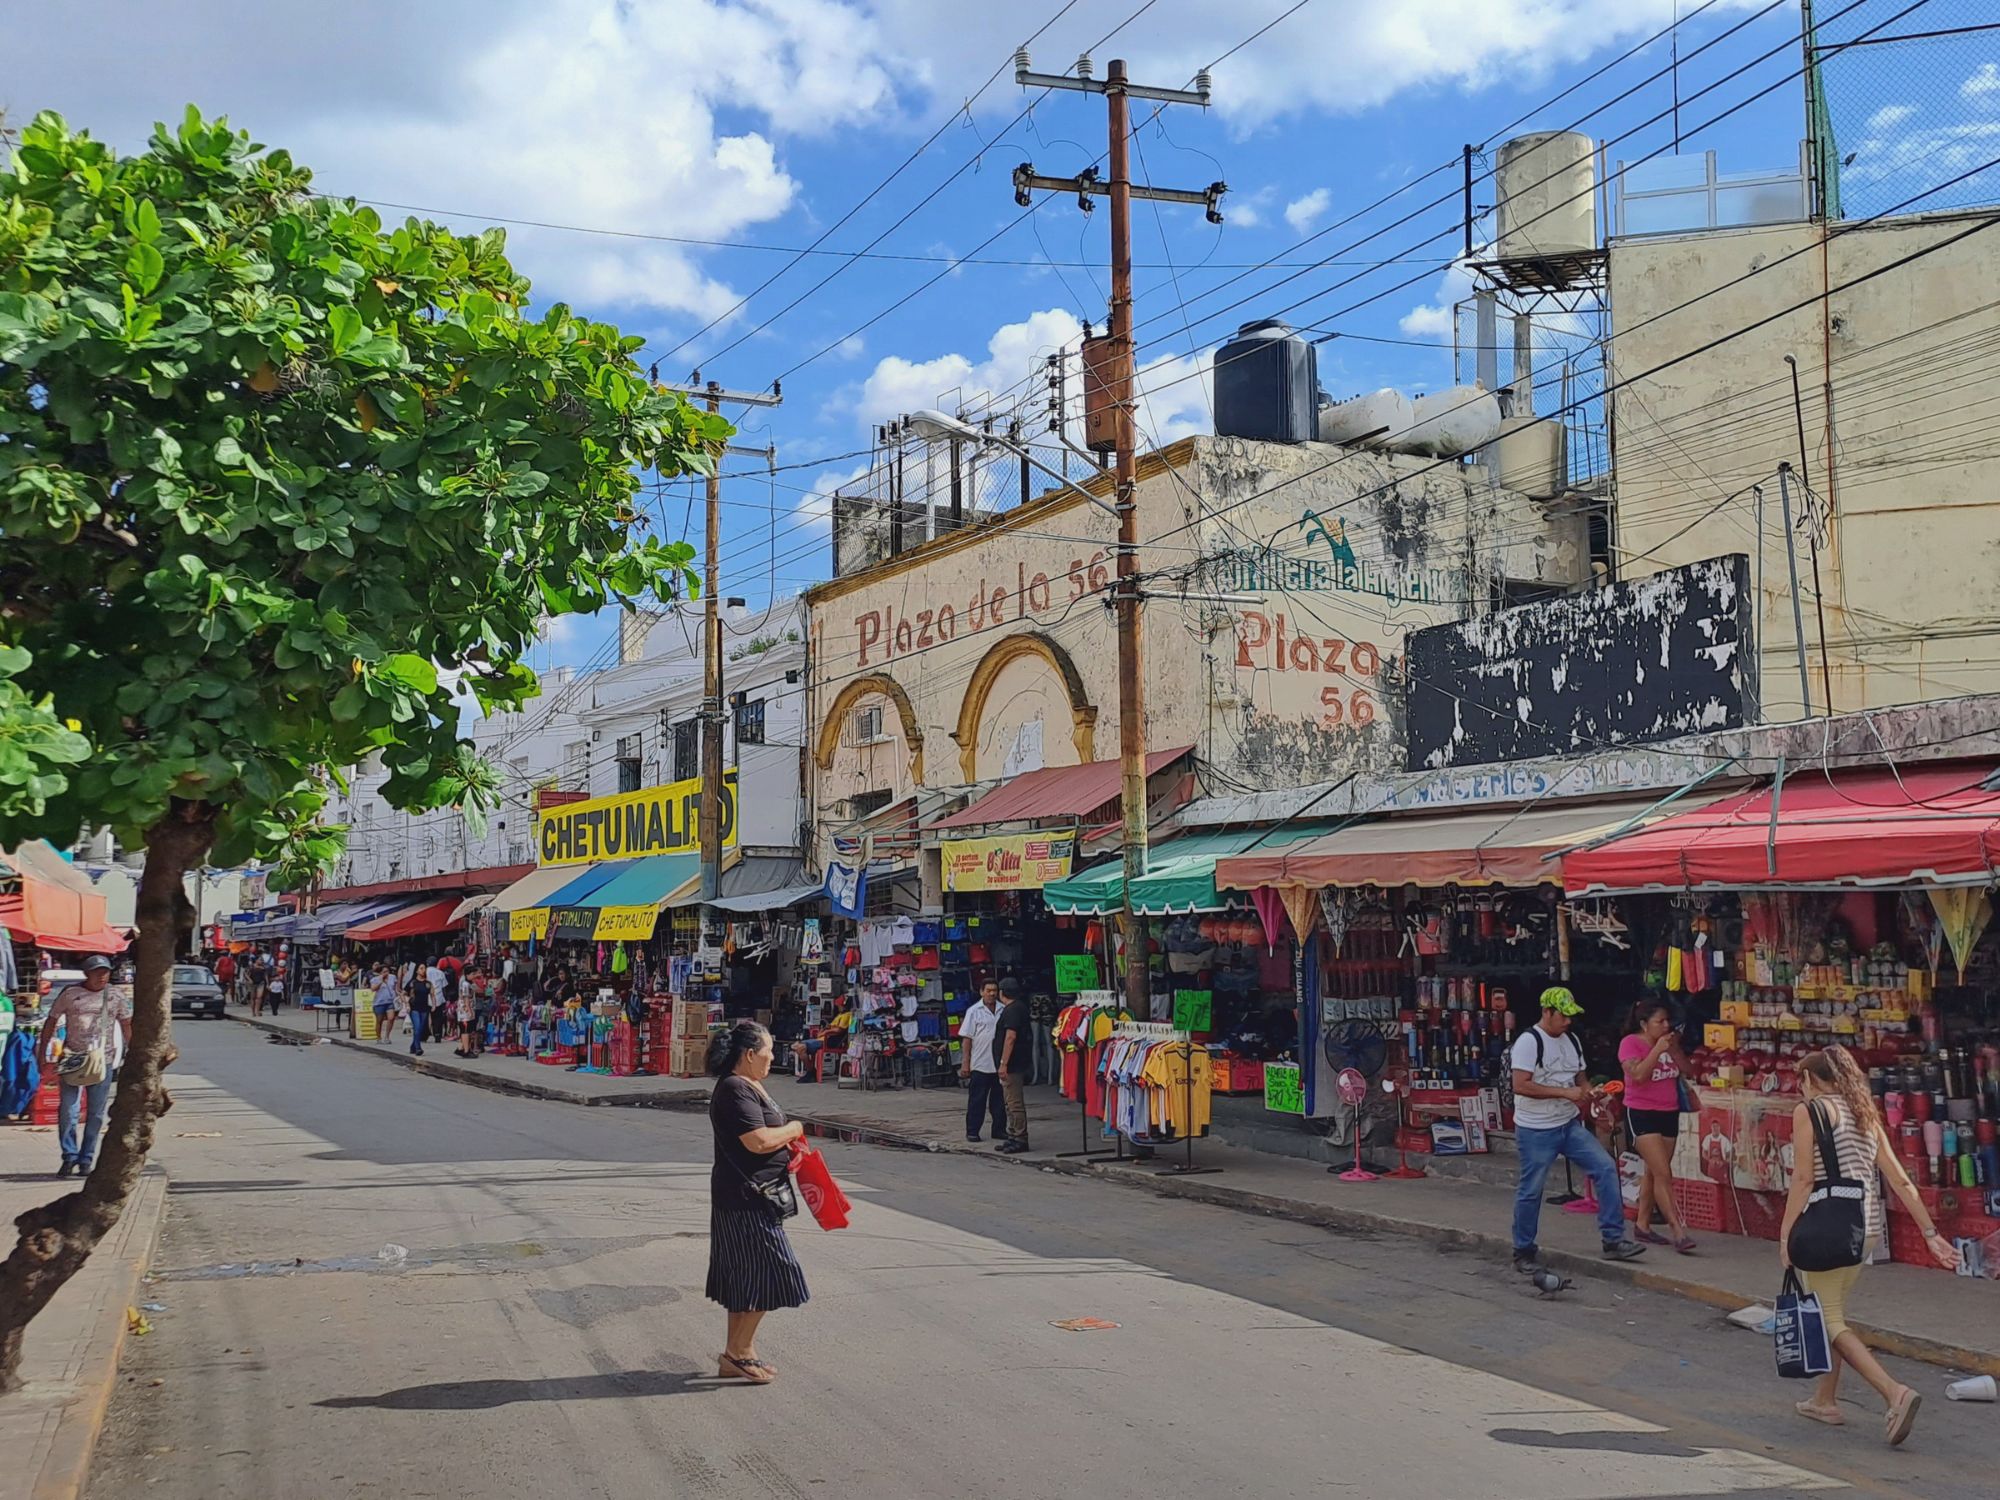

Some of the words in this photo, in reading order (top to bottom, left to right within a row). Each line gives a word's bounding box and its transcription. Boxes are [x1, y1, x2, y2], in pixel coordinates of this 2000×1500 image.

[855, 603, 955, 667] Plaza
[968, 578, 1007, 631] de
[1018, 561, 1050, 618] la
[1068, 552, 1109, 600] 56
[1235, 610, 1380, 676] Plaza
[1320, 686, 1375, 724] 56
[542, 784, 734, 861] CHETUMALITO
[511, 912, 548, 931] CHETUMALITO
[556, 910, 593, 929] ETUMALITO
[599, 911, 654, 932] CHETUMALITO
[1651, 1067, 1680, 1081] Barbi
